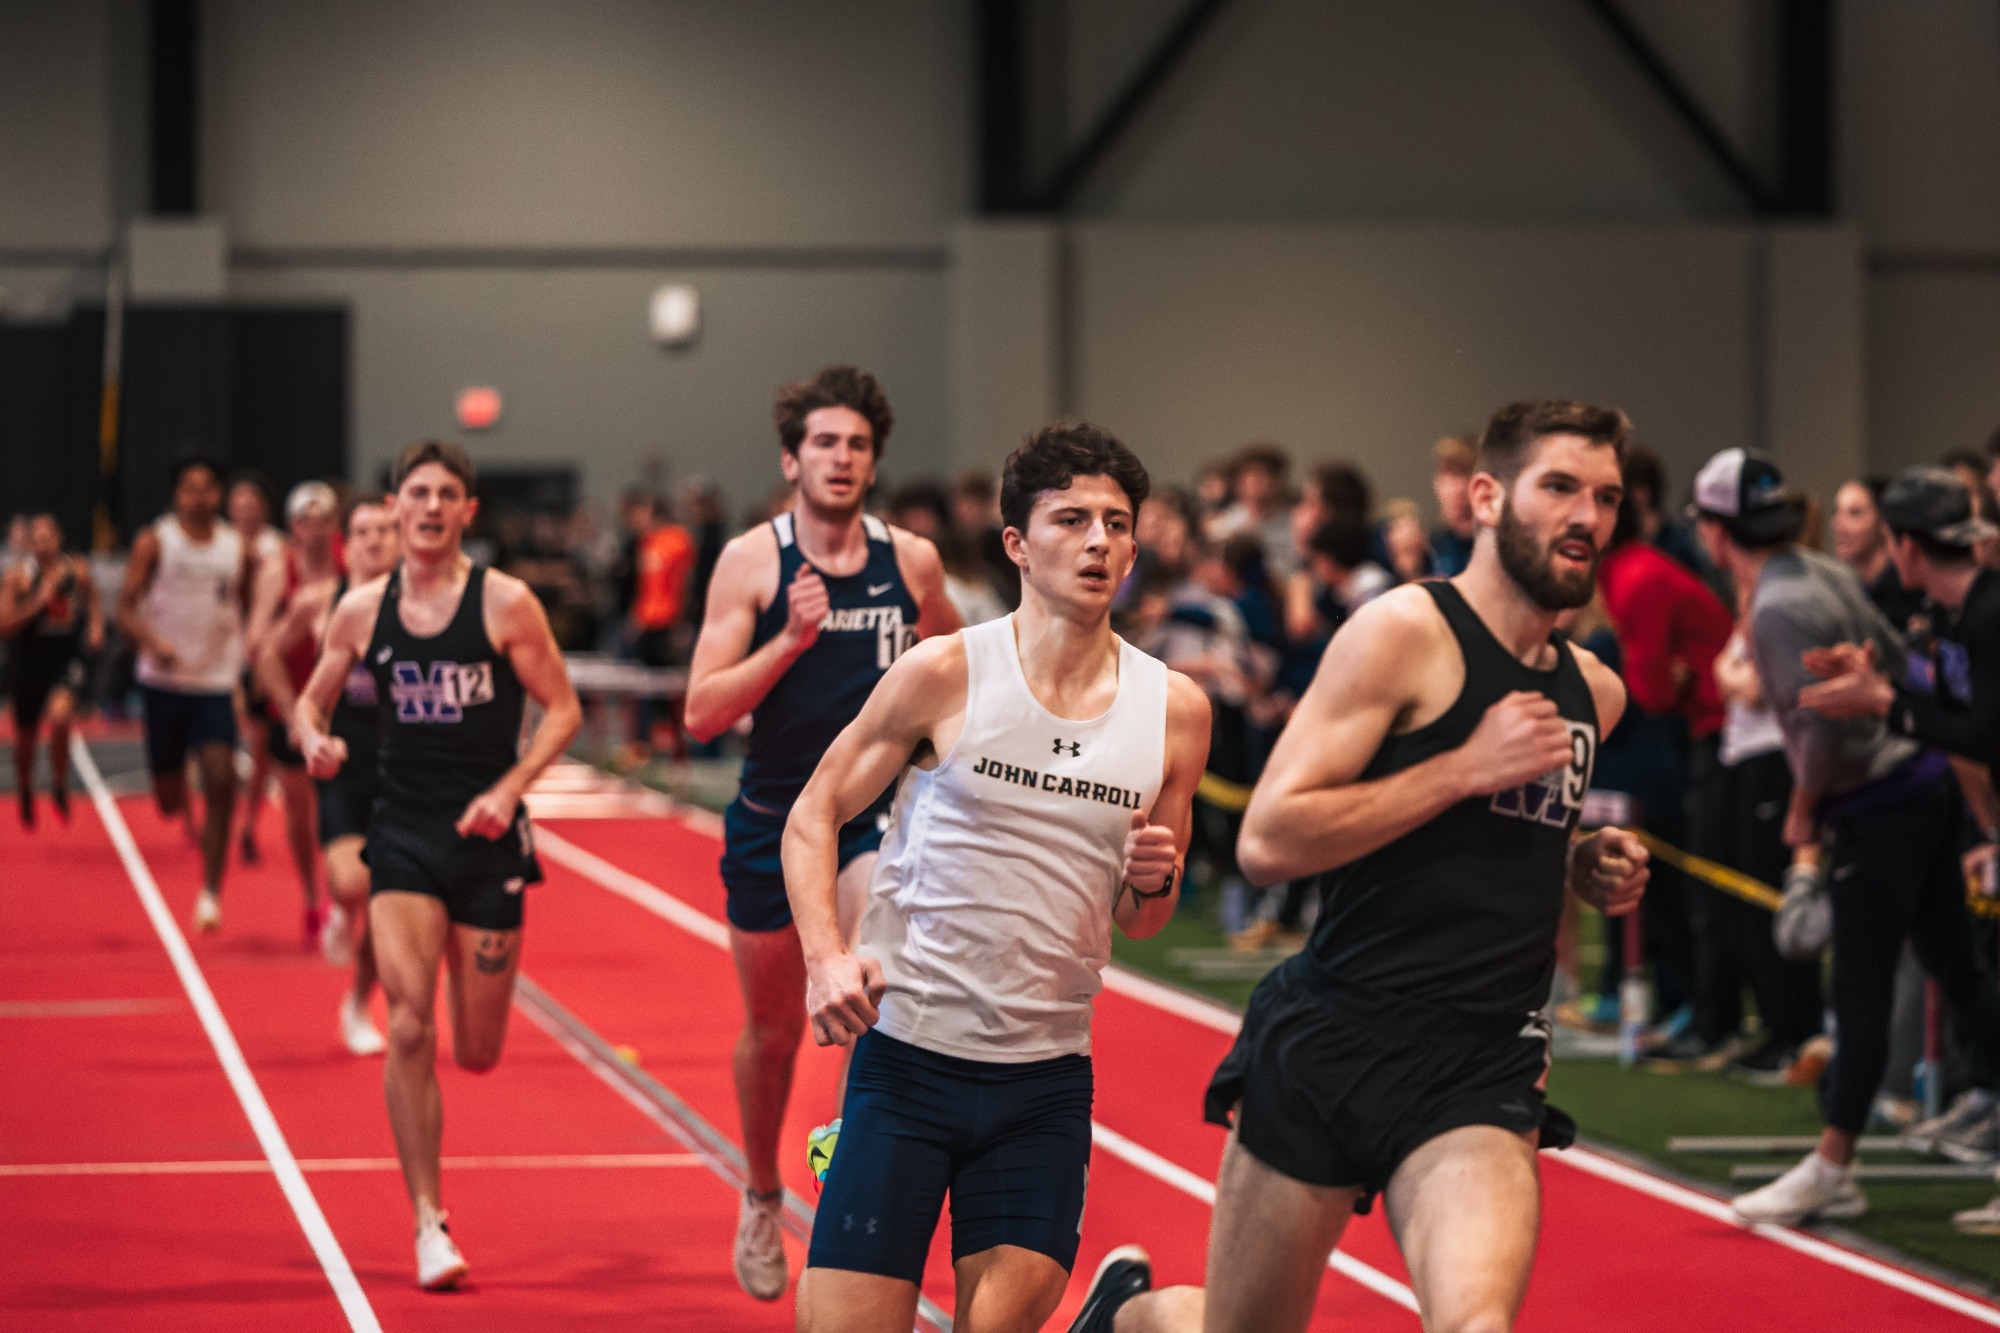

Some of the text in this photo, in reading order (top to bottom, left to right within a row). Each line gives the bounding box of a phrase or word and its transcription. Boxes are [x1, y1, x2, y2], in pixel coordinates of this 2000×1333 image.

[818, 605, 903, 632] ARIETTA
[451, 668, 485, 700] 12
[973, 756, 1142, 809] JOHN CARROLL
[1570, 730, 1589, 802] 9
